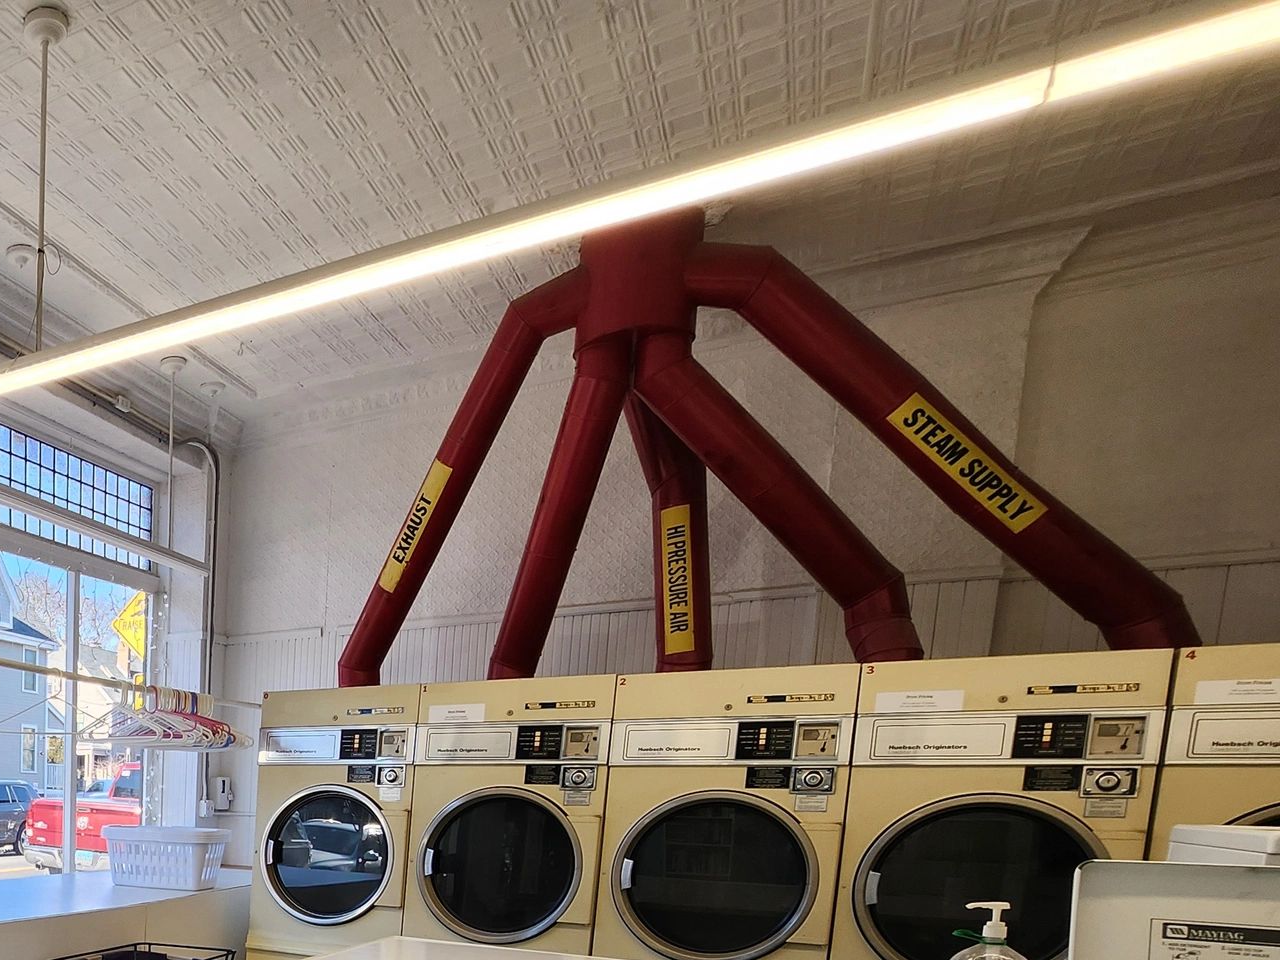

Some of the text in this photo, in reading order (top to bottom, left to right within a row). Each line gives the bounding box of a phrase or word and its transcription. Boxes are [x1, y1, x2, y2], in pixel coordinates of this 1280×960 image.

[903, 408, 1034, 521] STEAM SUPPLY
[392, 493, 433, 564] EXHAUST
[666, 524, 689, 634] HI PRESSURE AIR
[1185, 650, 1196, 660] 4
[866, 666, 875, 674] 3
[619, 678, 627, 686] 2
[1189, 929, 1244, 940] MAYTAG
